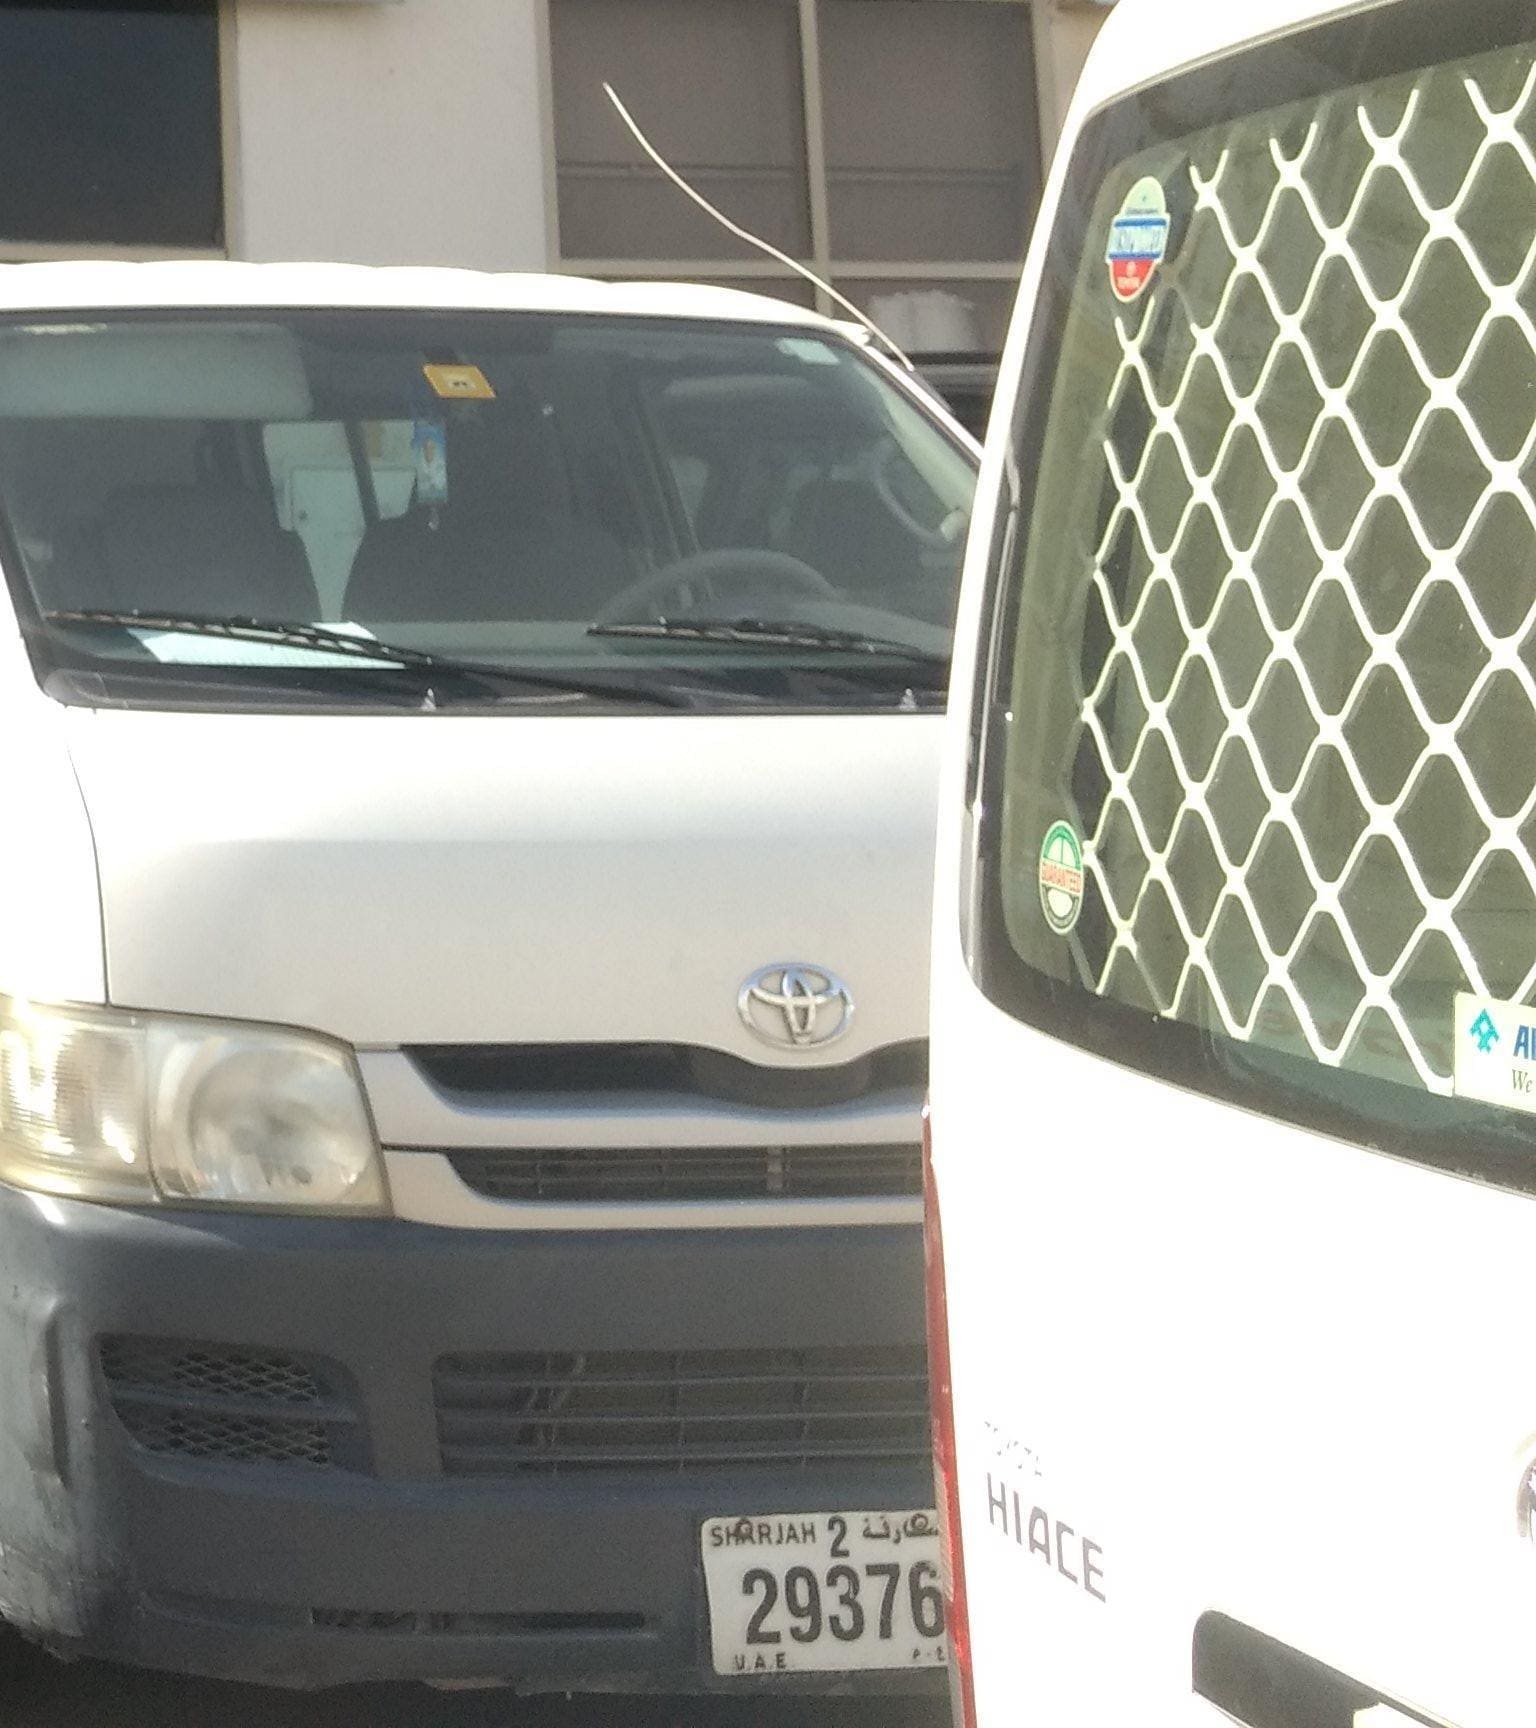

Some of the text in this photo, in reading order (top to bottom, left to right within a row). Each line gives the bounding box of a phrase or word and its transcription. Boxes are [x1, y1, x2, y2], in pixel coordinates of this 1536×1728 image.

[711, 1515, 850, 1557] SHARJAH 2
[986, 1472, 1106, 1603] HIACE
[742, 1560, 946, 1645] 29376
